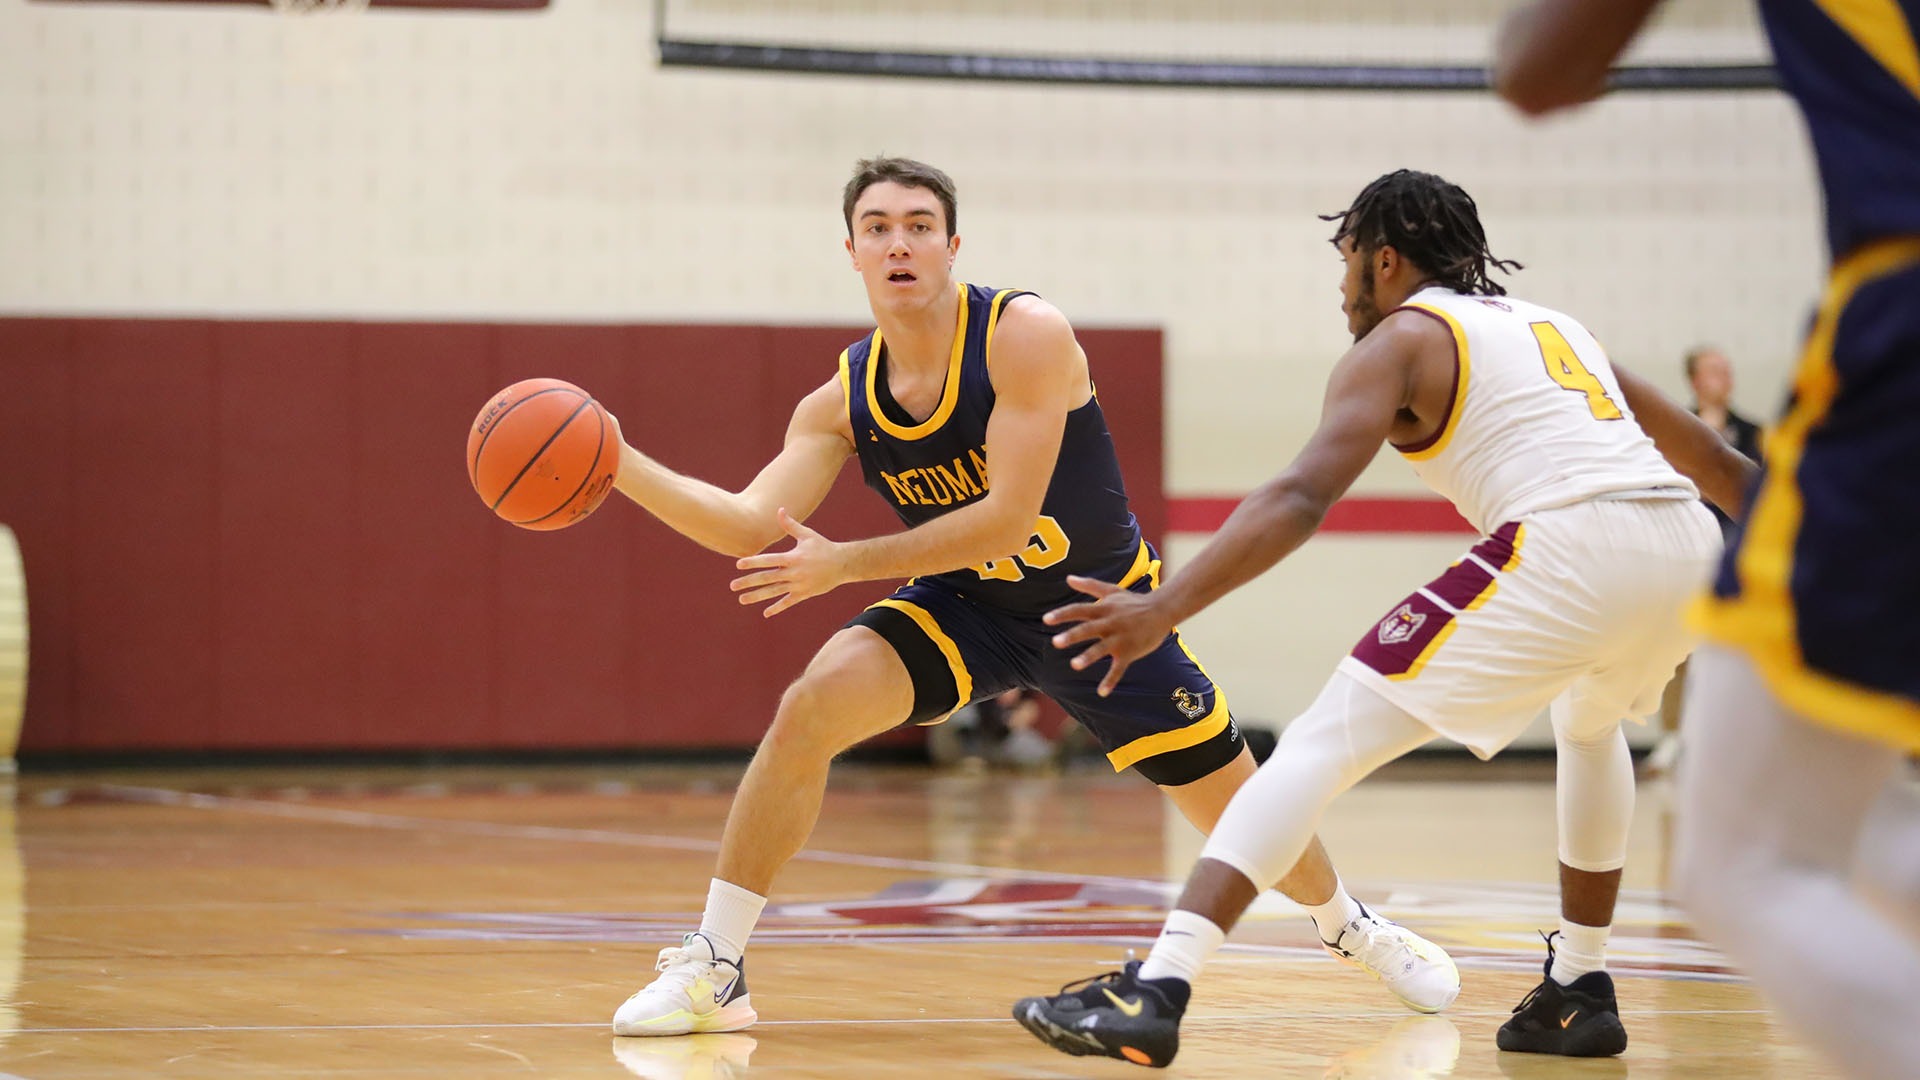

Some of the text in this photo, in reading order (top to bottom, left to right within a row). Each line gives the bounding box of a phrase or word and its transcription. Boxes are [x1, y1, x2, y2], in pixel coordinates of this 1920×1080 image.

[1528, 320, 1625, 421] 4
[478, 399, 508, 434] ROCK
[880, 444, 990, 506] NEUMA
